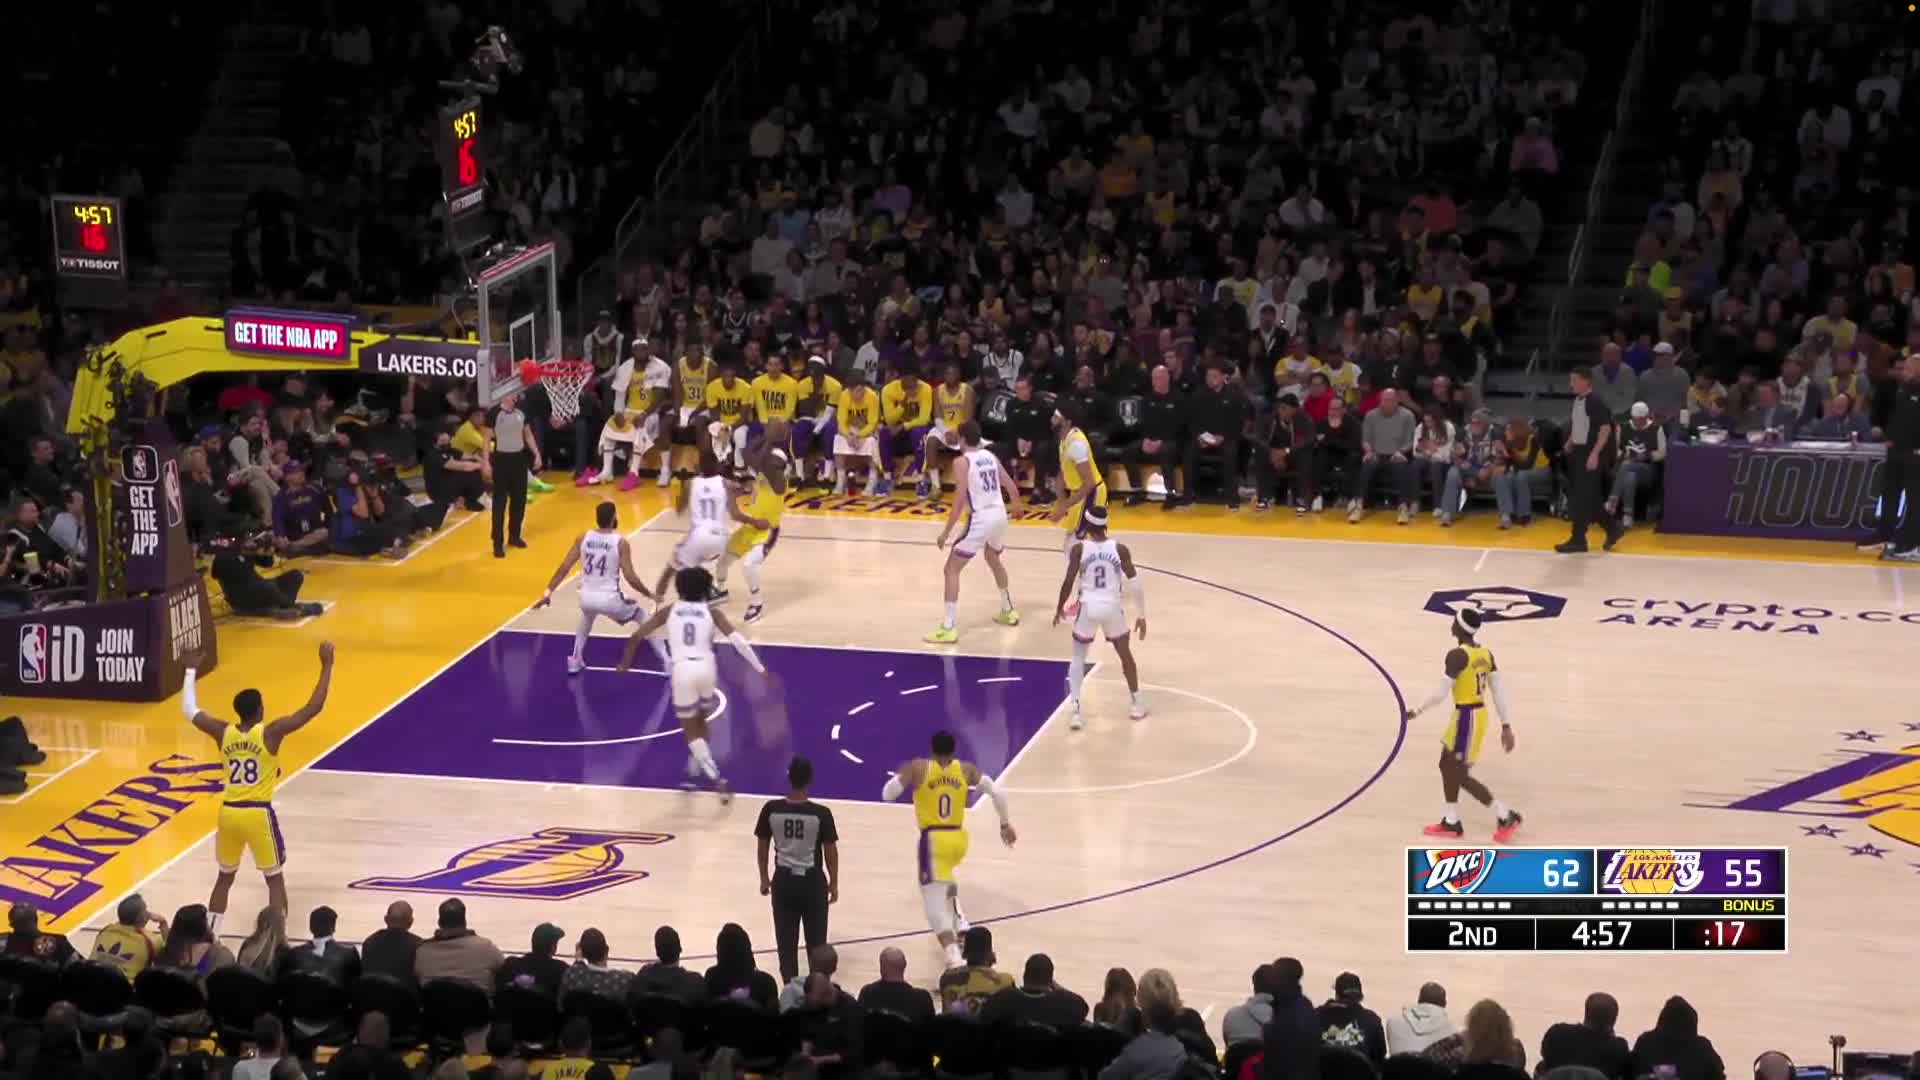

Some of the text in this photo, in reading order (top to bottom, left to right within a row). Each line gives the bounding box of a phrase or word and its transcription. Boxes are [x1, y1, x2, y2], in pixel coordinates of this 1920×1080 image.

[454, 111, 477, 139] 4:57
[74, 206, 112, 225] 4:57
[82, 224, 106, 252] 16
[76, 258, 120, 270] TISSOT
[235, 321, 338, 351] GET THE NBA APP
[377, 353, 477, 378] LAKERS.CO
[980, 469, 998, 492] 33
[129, 486, 155, 508] GET
[131, 509, 158, 531] THE
[131, 533, 159, 555] APP
[584, 553, 608, 577] 34
[1095, 565, 1106, 589] 2
[683, 622, 696, 646] 8
[1598, 614, 1819, 635] ARENA
[96, 628, 133, 654] JOIN
[96, 656, 145, 682] TODAY
[229, 758, 258, 784] 28
[938, 793, 952, 818] 0
